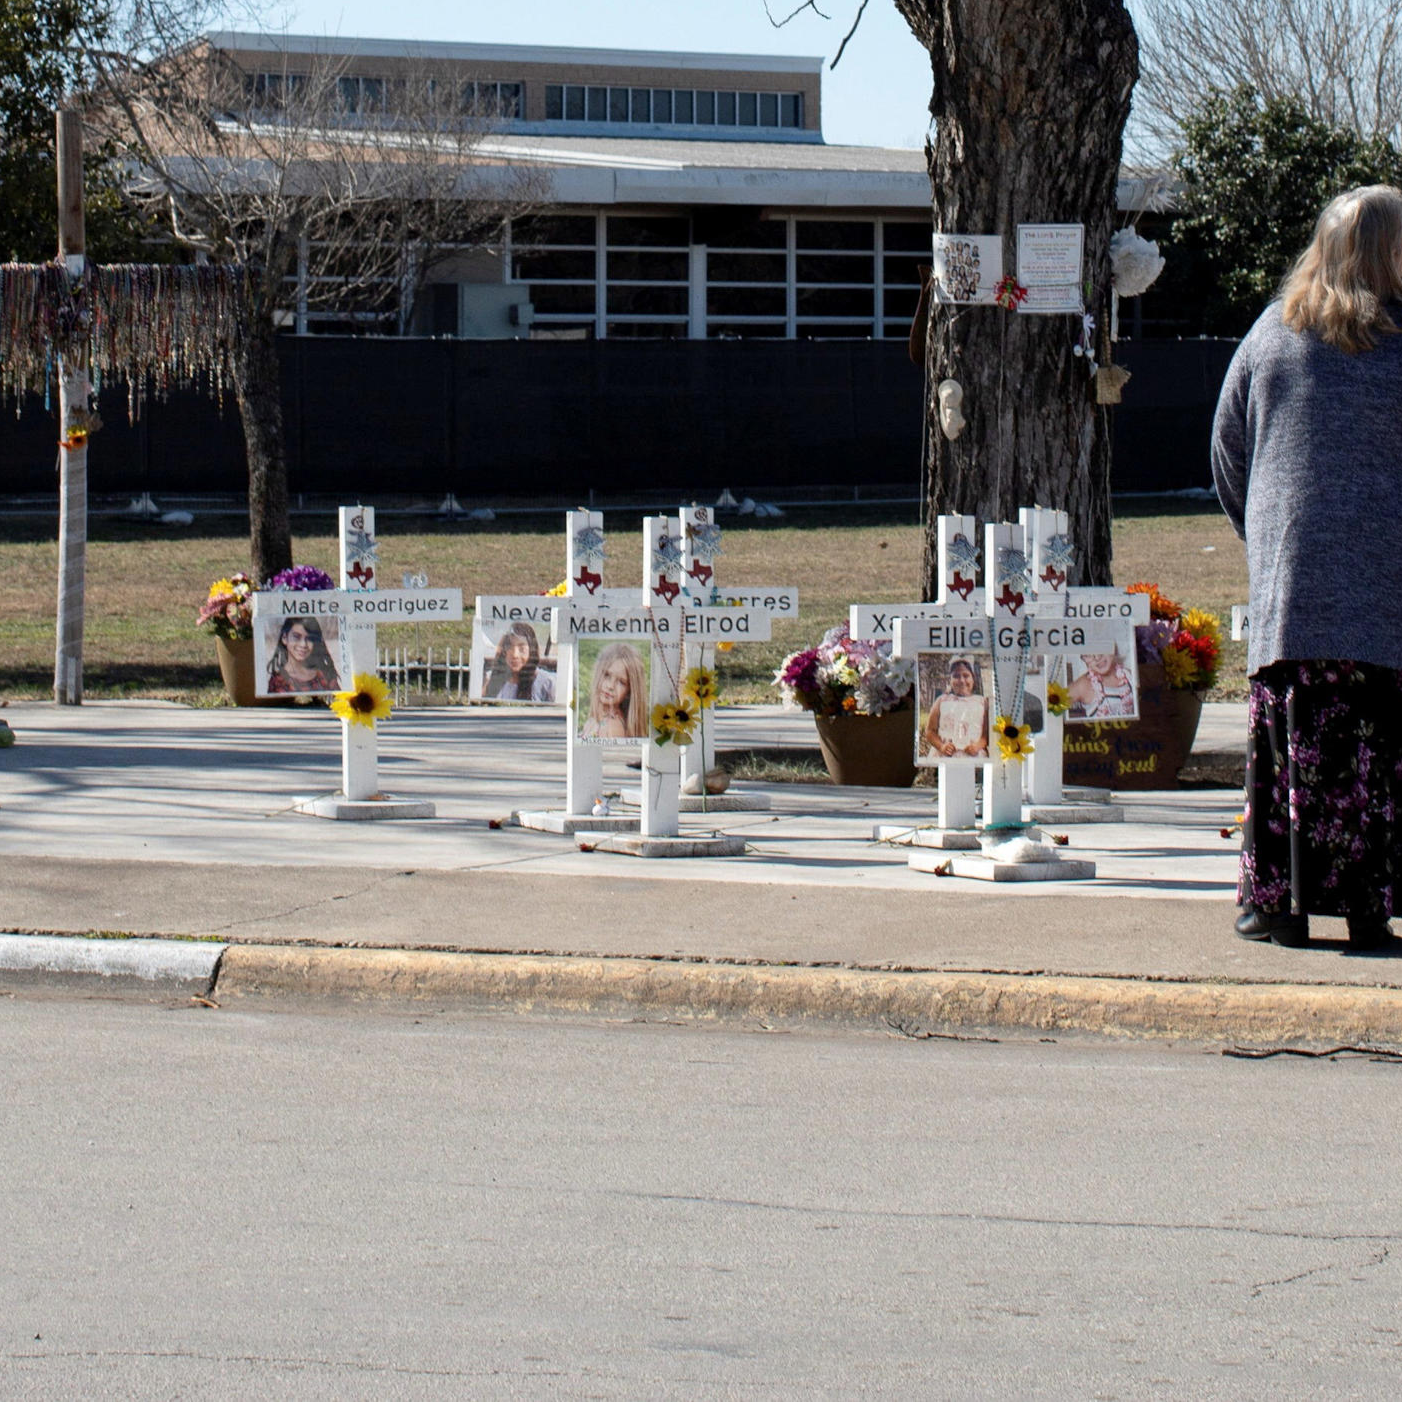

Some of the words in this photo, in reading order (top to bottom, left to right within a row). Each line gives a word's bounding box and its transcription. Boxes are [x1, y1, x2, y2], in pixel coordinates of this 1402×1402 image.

[282, 599, 340, 615] Maite
[353, 597, 449, 615] Rodriguez
[492, 604, 552, 622] Neva
[569, 616, 670, 634] Makenna
[685, 613, 750, 634] Elrod
[929, 625, 984, 648] Ellie
[998, 624, 1086, 649] Garcia
